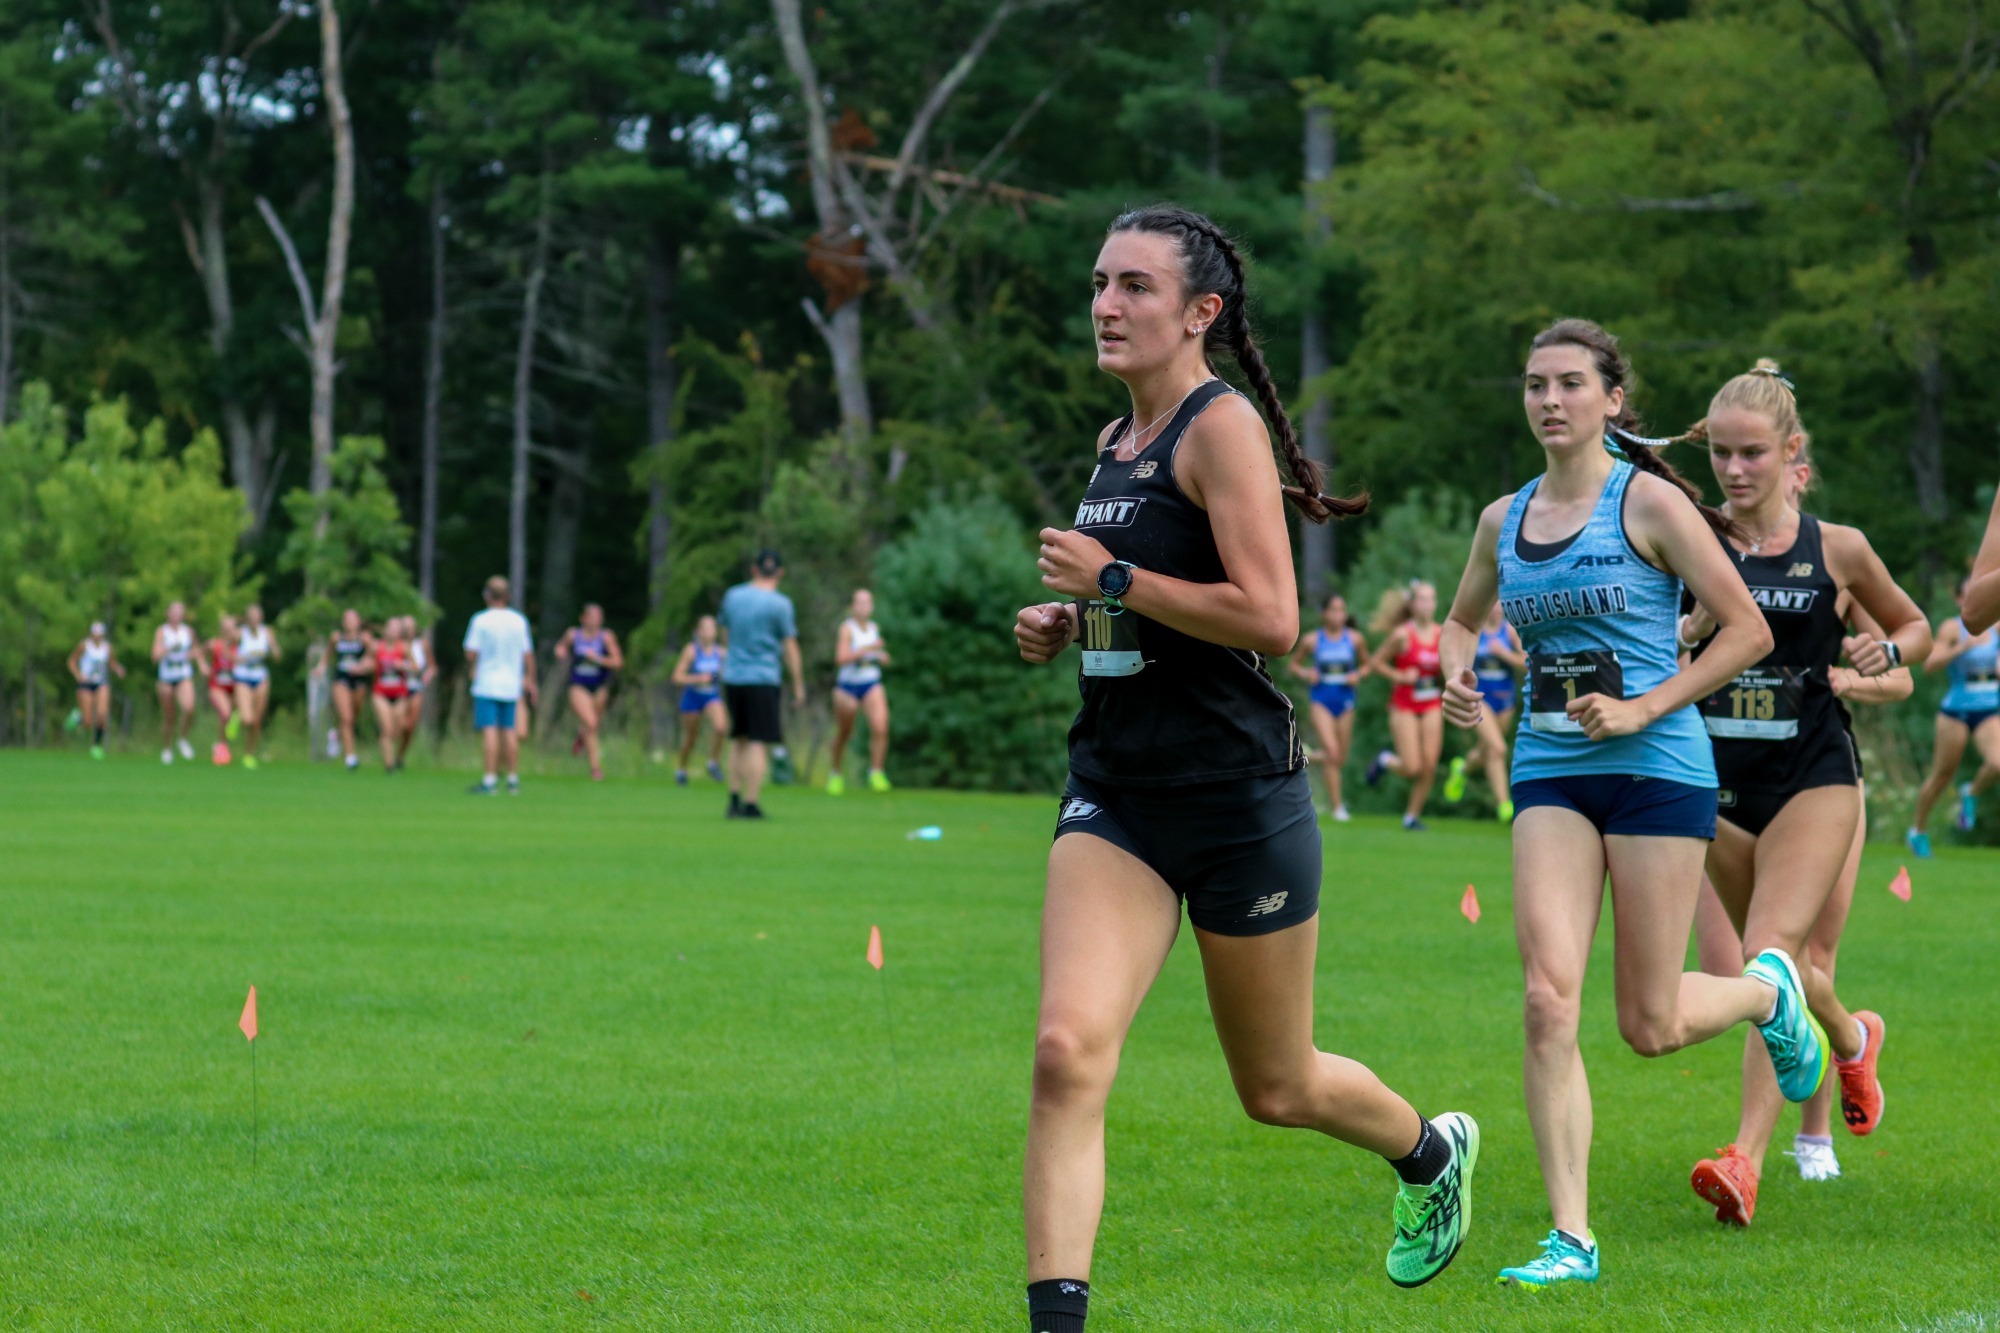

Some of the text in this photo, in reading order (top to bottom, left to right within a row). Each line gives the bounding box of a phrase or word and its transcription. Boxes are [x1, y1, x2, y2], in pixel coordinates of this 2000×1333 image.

[1541, 584, 1628, 620] ISLAND
[1084, 607, 1112, 651] 110
[1562, 678, 1577, 702] 1
[1728, 688, 1775, 721] 113
